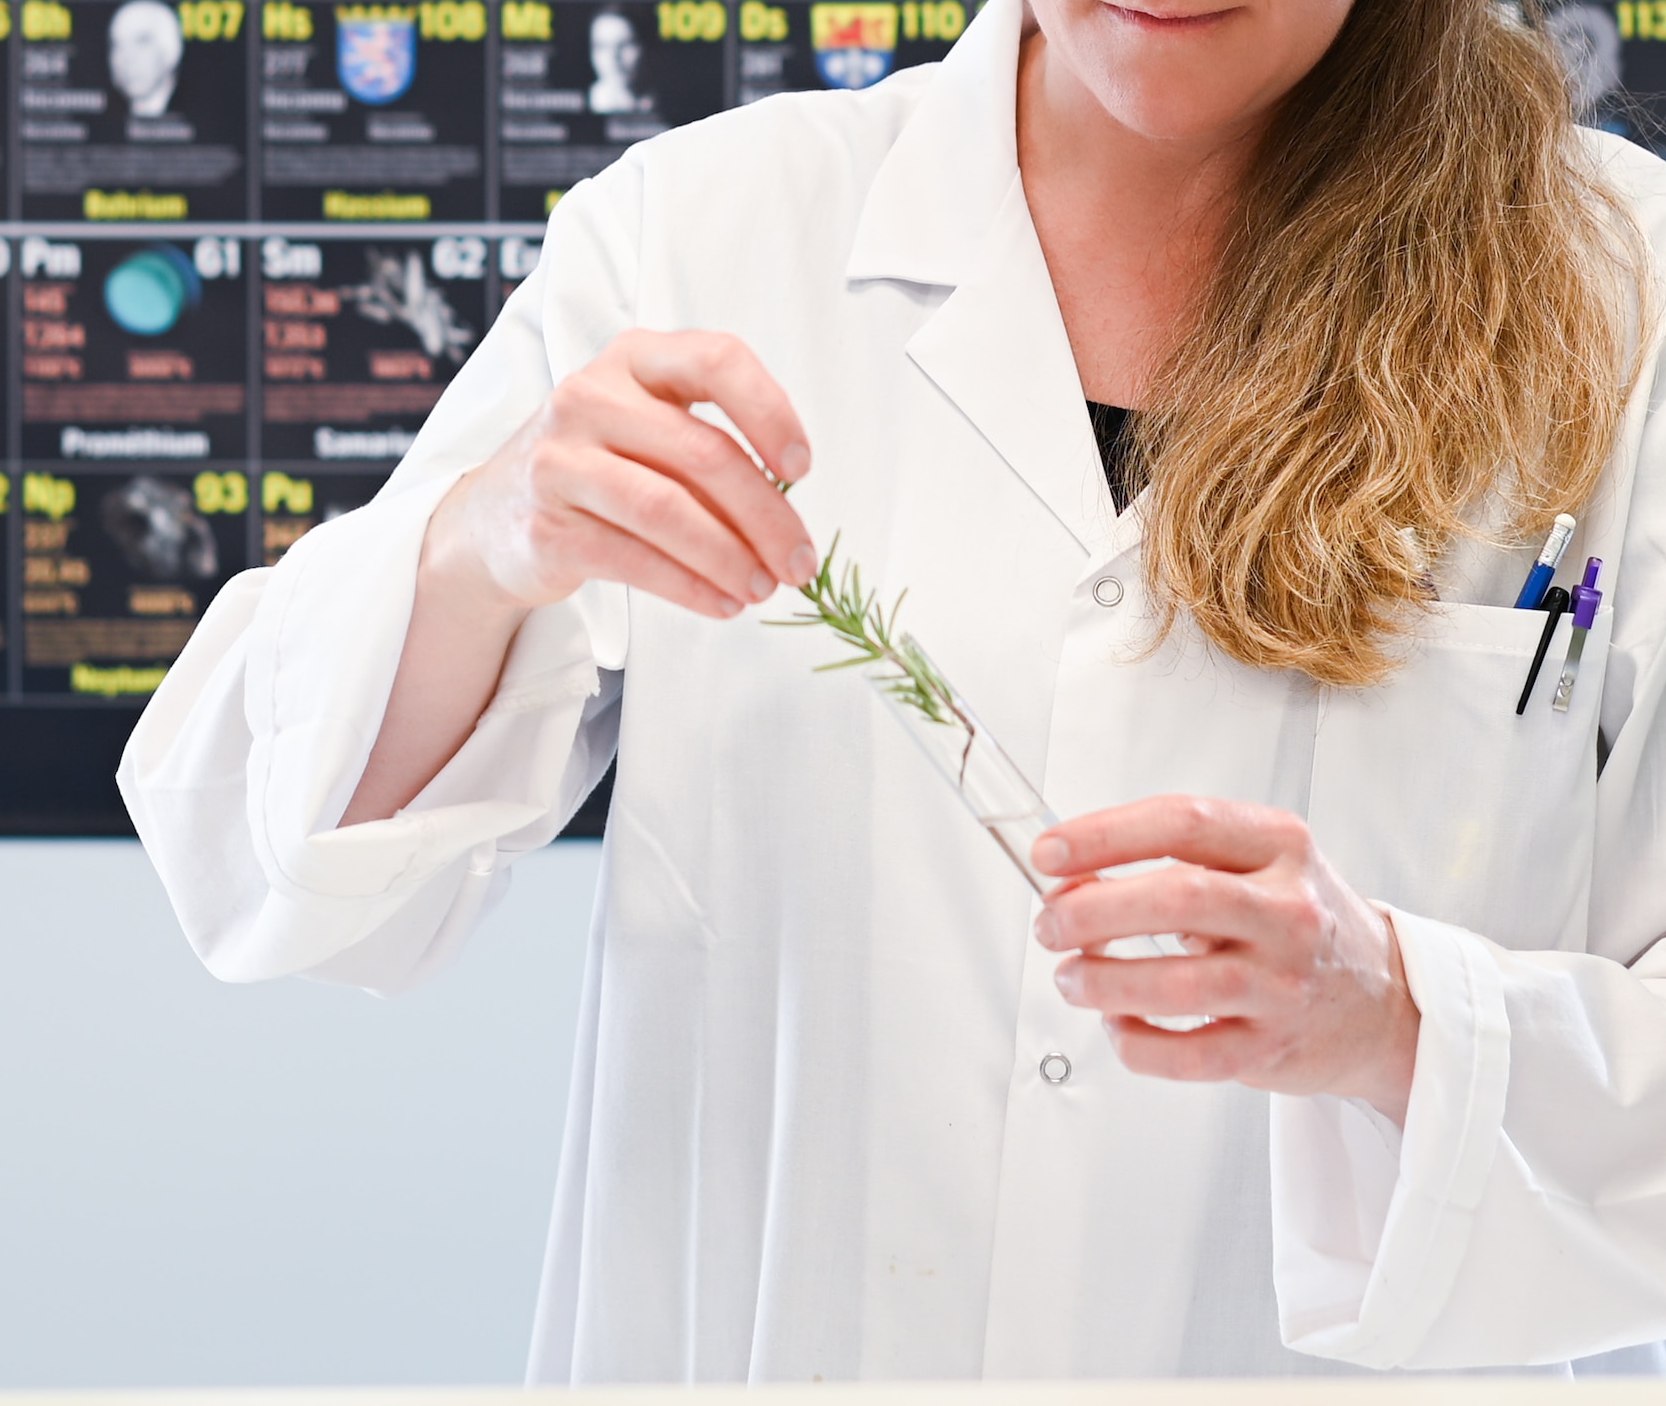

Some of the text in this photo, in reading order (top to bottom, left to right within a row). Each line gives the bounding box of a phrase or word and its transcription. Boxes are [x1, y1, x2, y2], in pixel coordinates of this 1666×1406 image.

[21, 0, 71, 39] Bh
[263, 2, 311, 39] Hs
[418, 0, 487, 42] 108
[658, 0, 727, 40] 109
[740, 0, 787, 40] Ds
[903, 0, 965, 41] 110
[23, 240, 81, 276] Pm
[195, 238, 243, 278] 61
[262, 240, 321, 278] Sm
[23, 473, 74, 520] Np
[195, 472, 248, 512] 93
[262, 472, 312, 512] Pu
